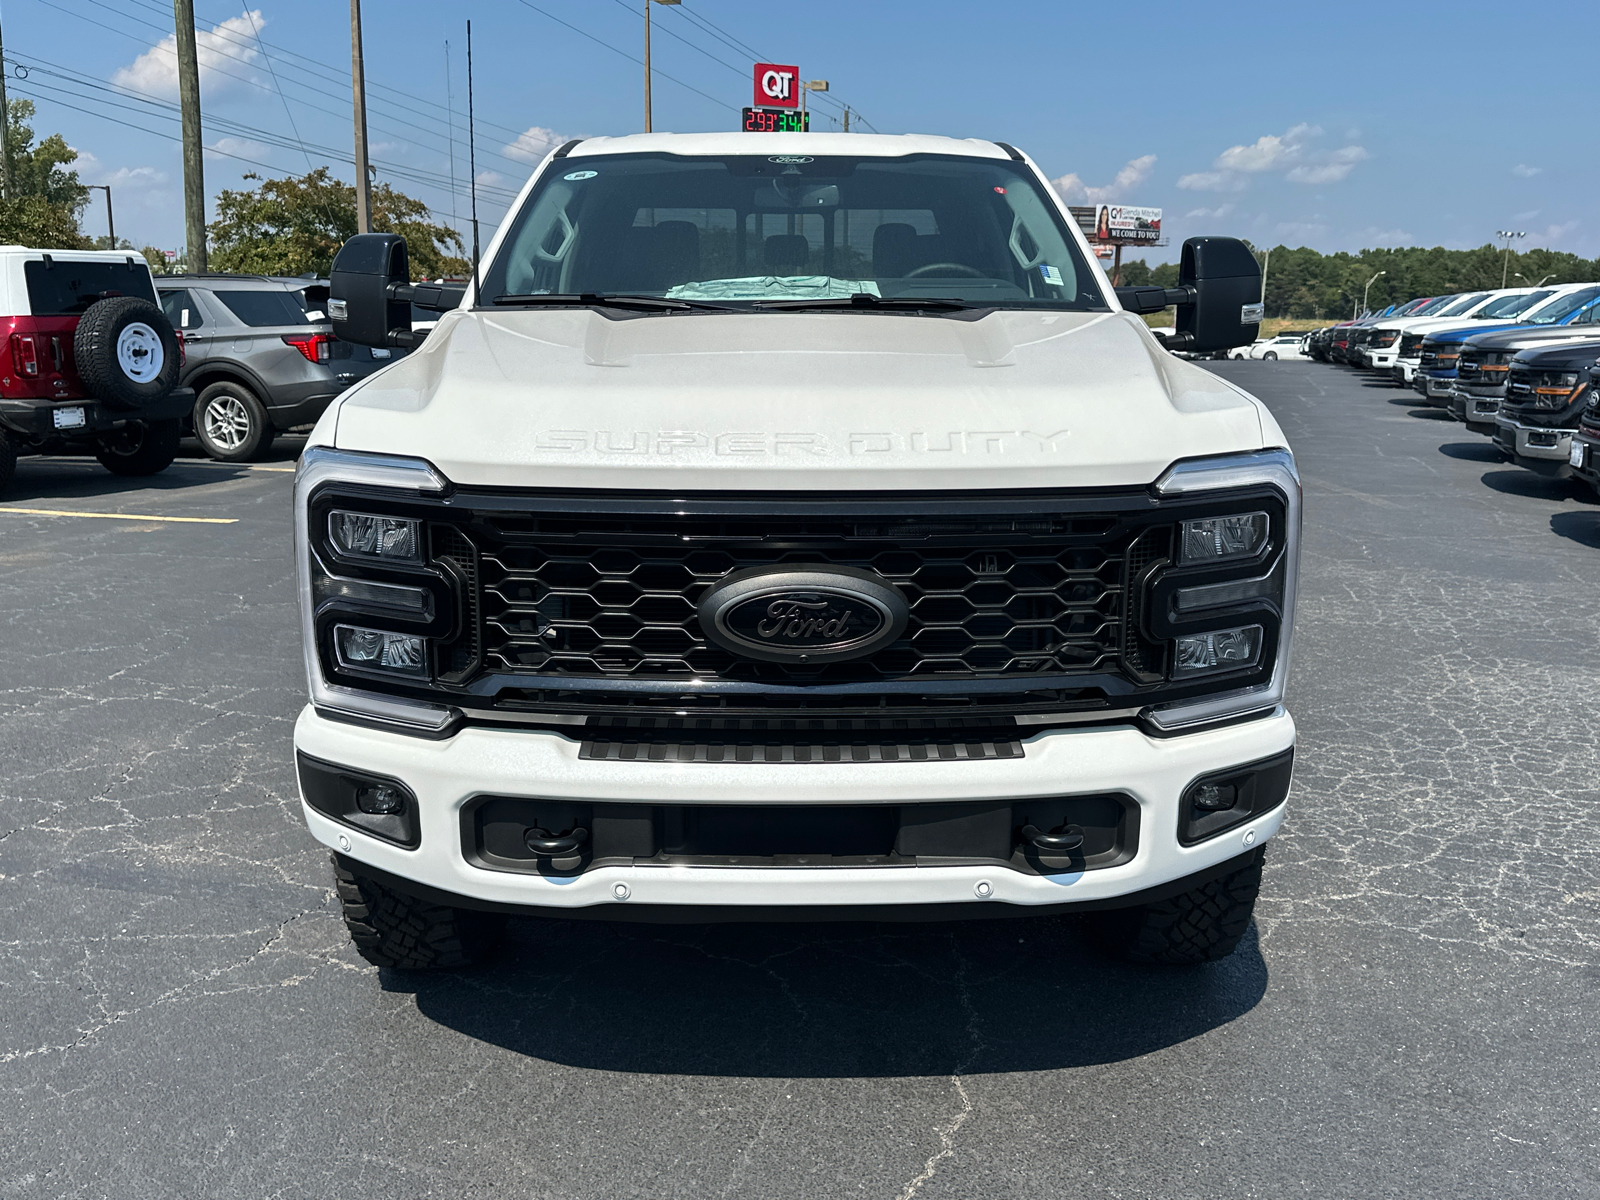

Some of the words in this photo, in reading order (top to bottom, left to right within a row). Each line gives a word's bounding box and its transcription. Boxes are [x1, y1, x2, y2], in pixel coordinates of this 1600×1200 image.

[762, 70, 793, 99] QT
[1120, 230, 1137, 238] COME
[534, 429, 832, 457] SUPER
[849, 430, 1072, 456] DUTY
[757, 599, 852, 638] Ford
